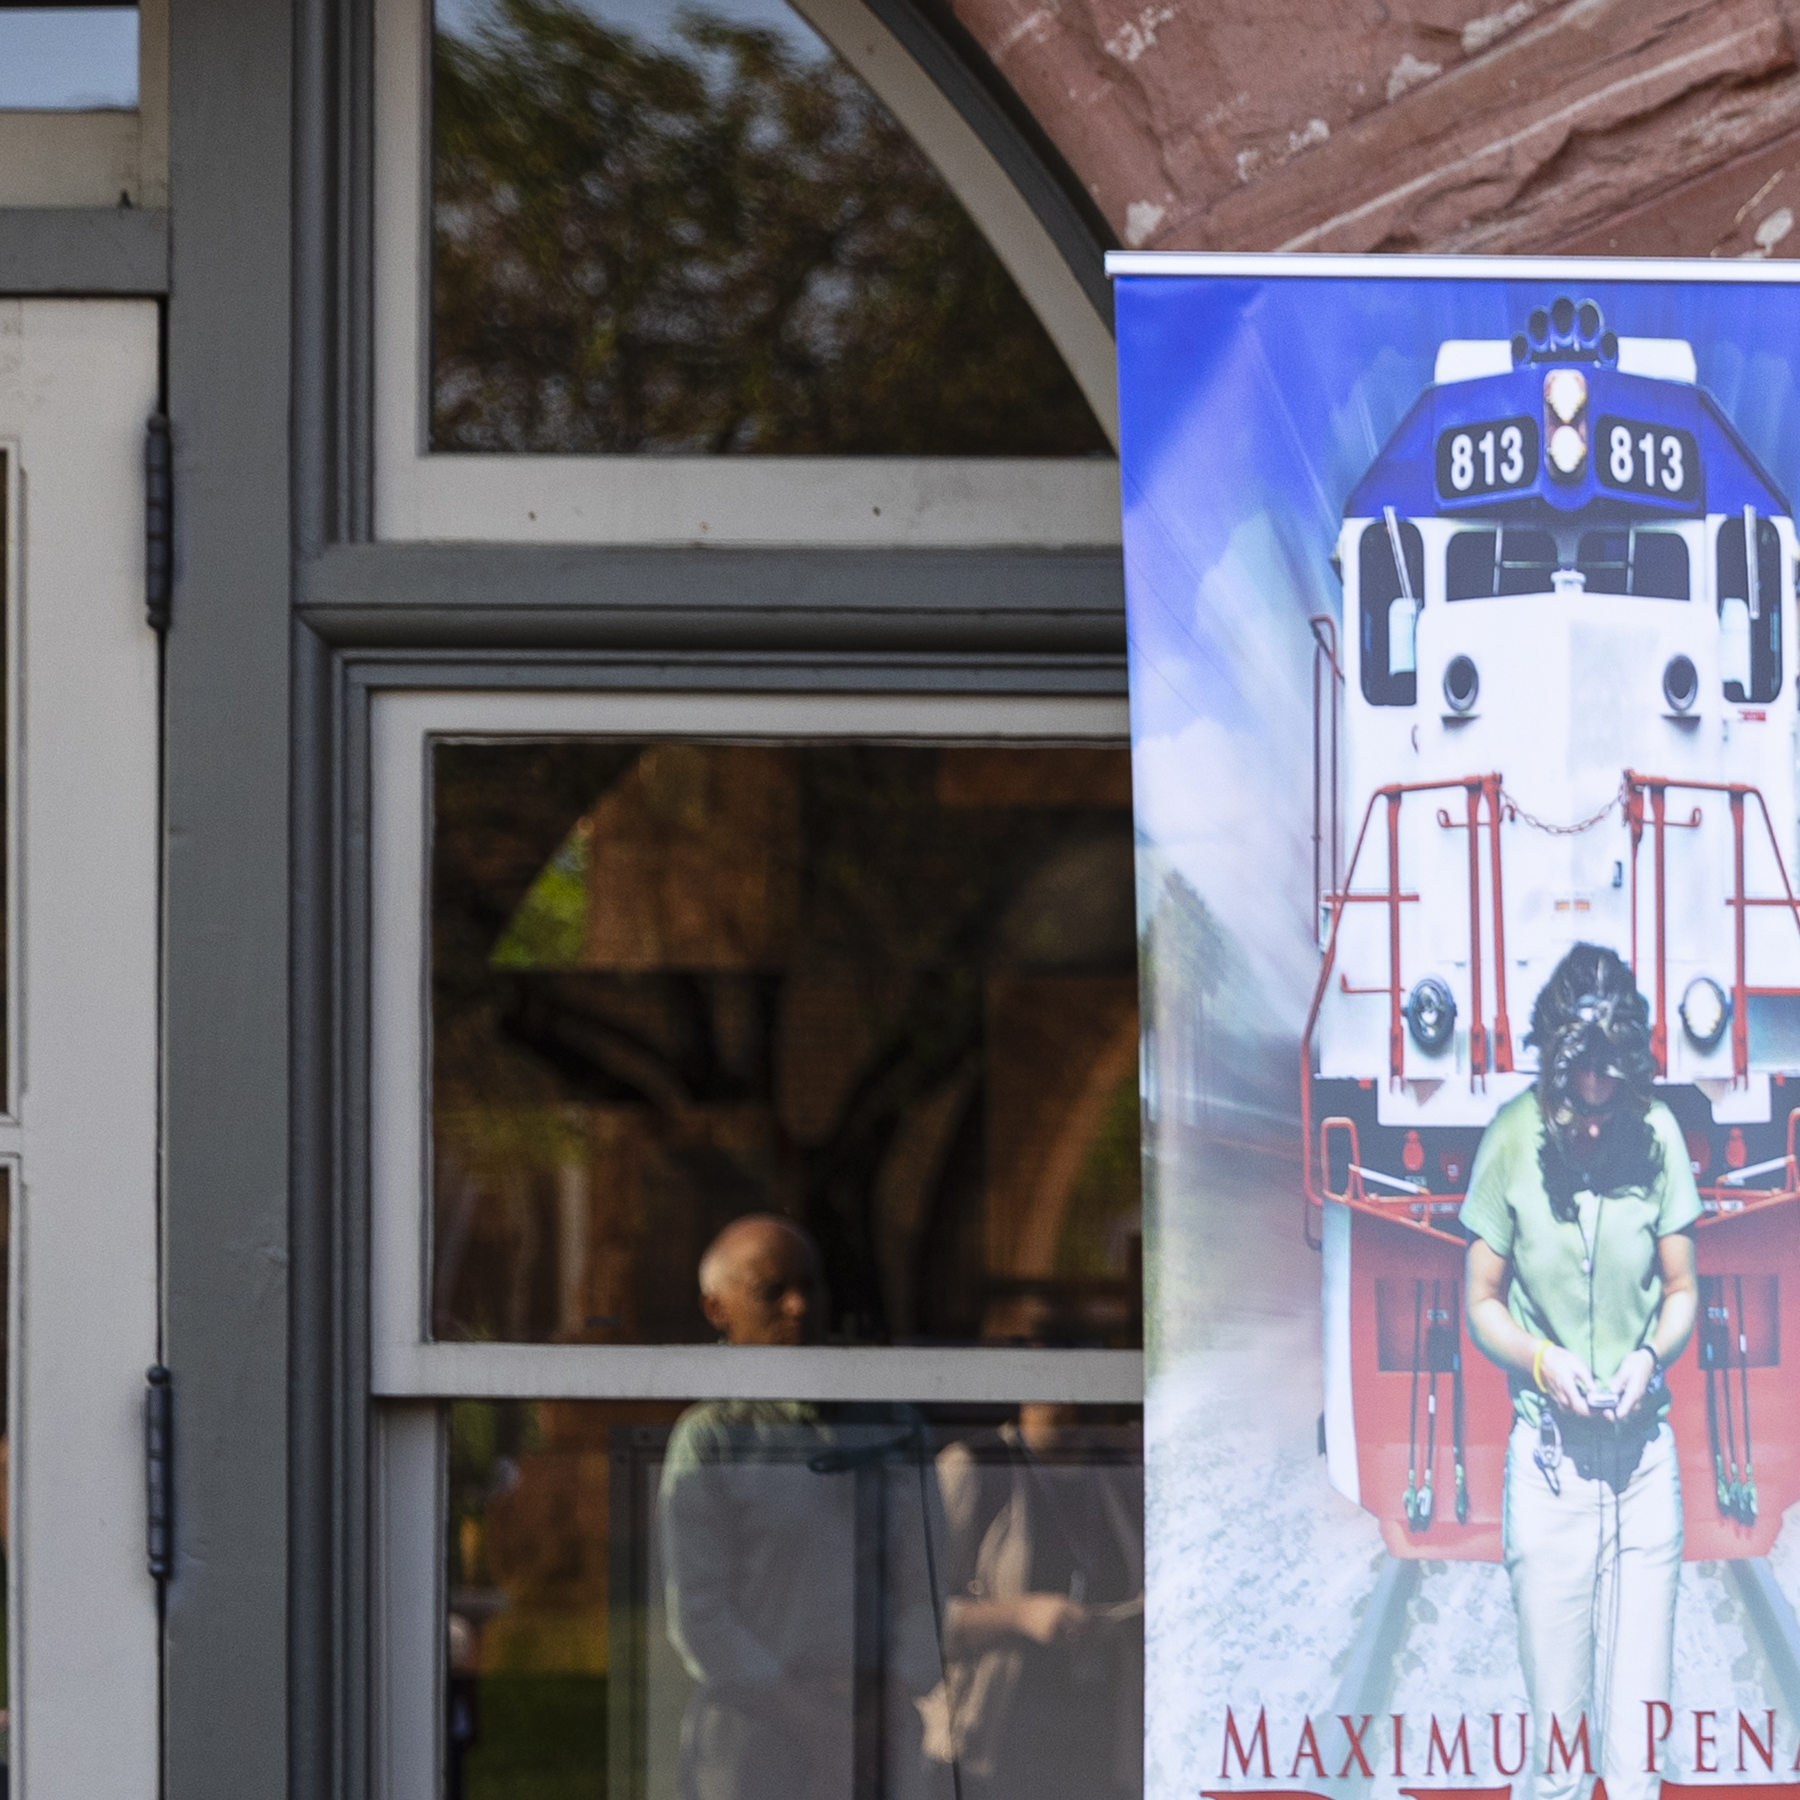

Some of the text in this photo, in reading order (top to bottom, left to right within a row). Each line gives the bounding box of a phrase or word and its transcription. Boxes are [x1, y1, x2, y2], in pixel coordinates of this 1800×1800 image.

[1450, 426, 1525, 491] 813
[1608, 426, 1685, 491] 813
[1220, 1704, 1596, 1780] MAXIMUM
